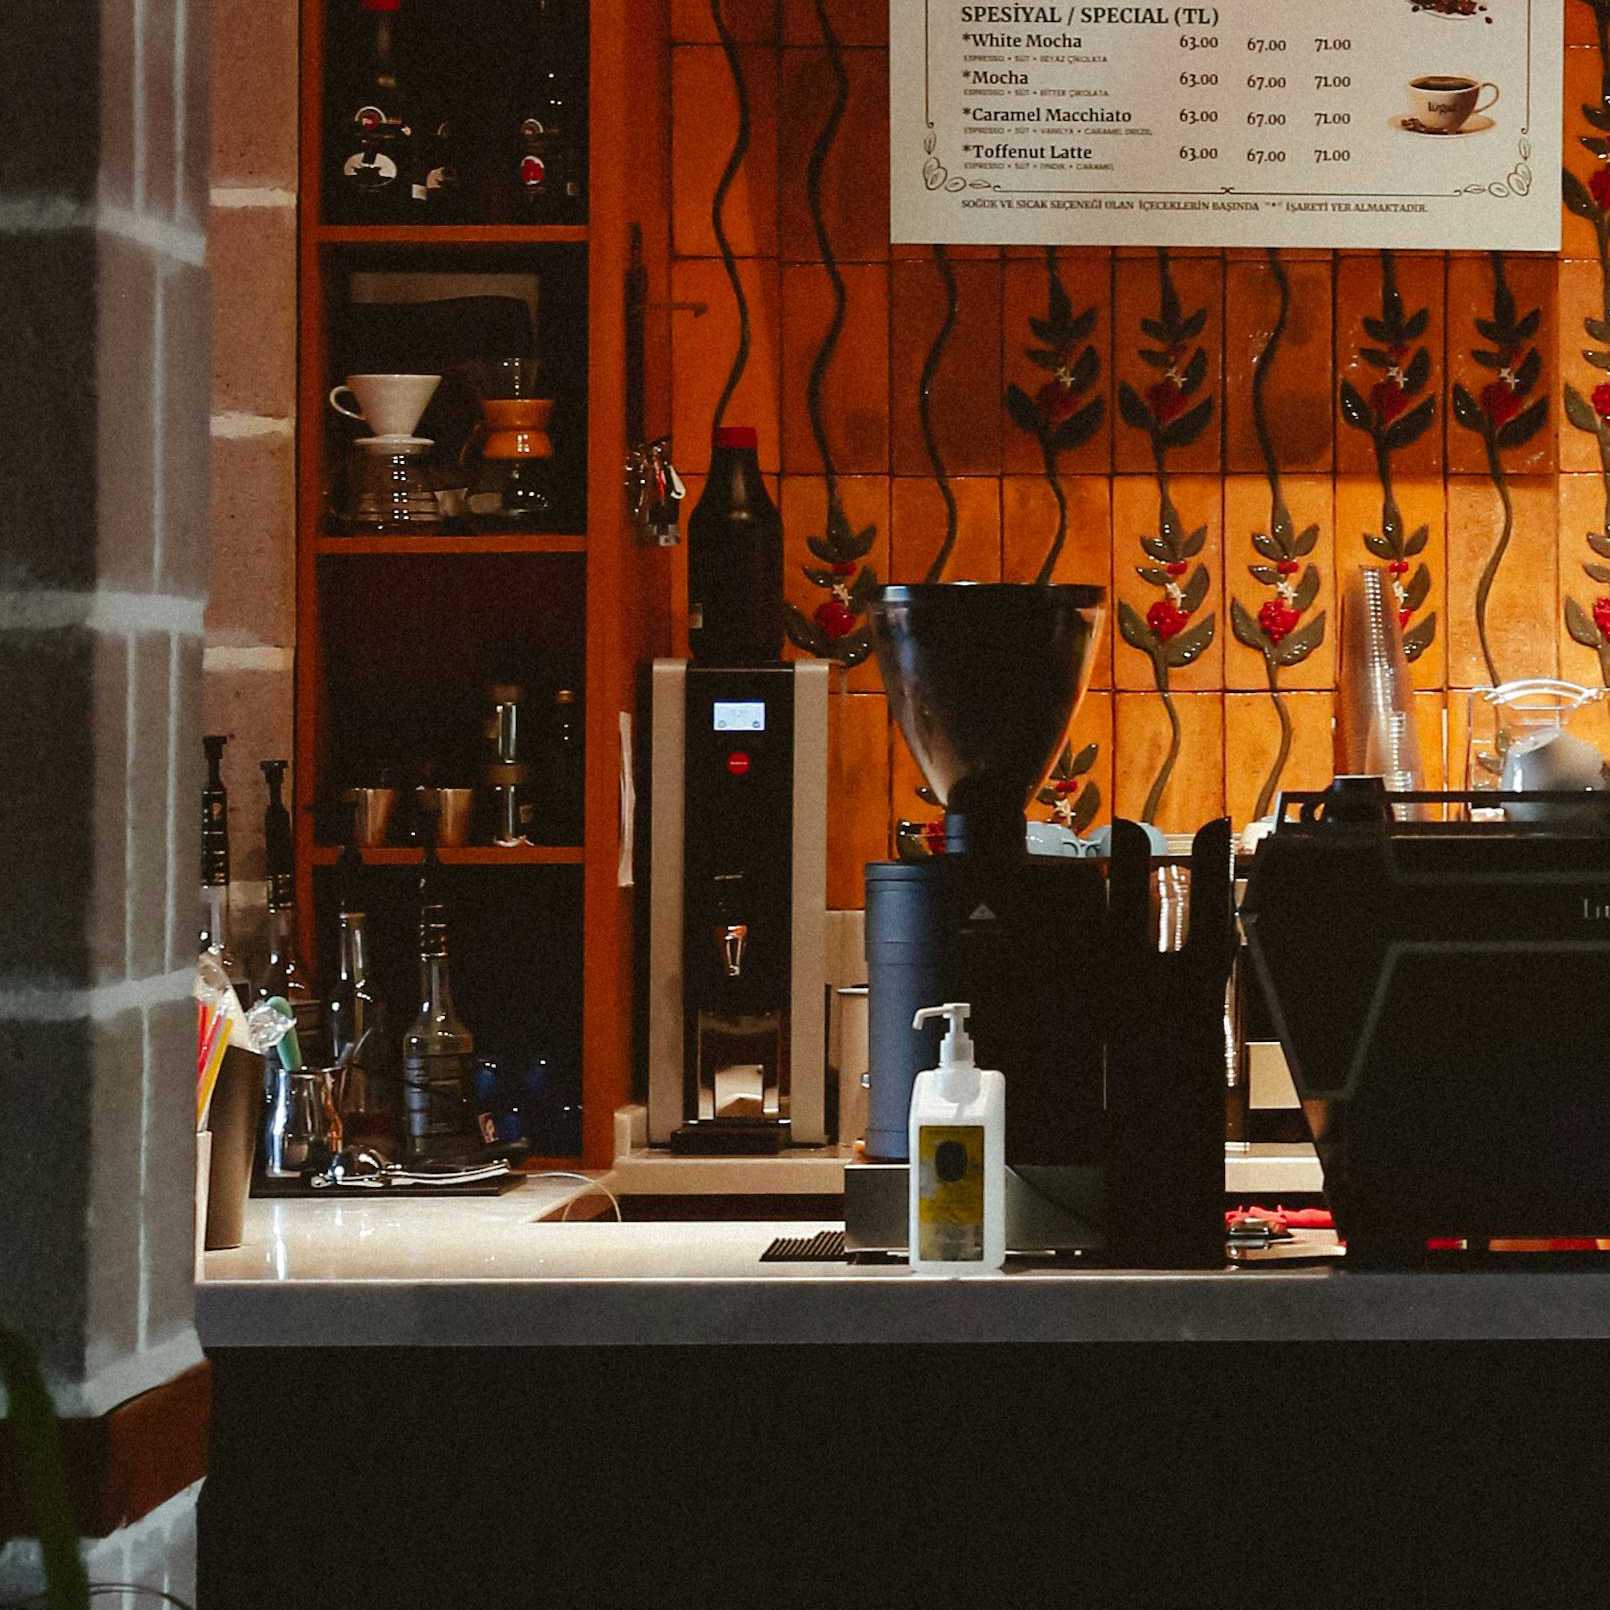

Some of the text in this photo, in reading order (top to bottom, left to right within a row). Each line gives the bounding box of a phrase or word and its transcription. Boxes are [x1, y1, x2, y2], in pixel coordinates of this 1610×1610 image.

[961, 2, 1062, 23] SPESİYAL
[1081, 7, 1169, 24] SPECIAL
[1174, 7, 1219, 27] (TL)
[1026, 33, 1082, 48] Mocha
[1045, 108, 1132, 122] Macchiato
[1050, 146, 1092, 159] Latte
[1179, 146, 1218, 161] 63.00
[1247, 148, 1286, 164] 67.00
